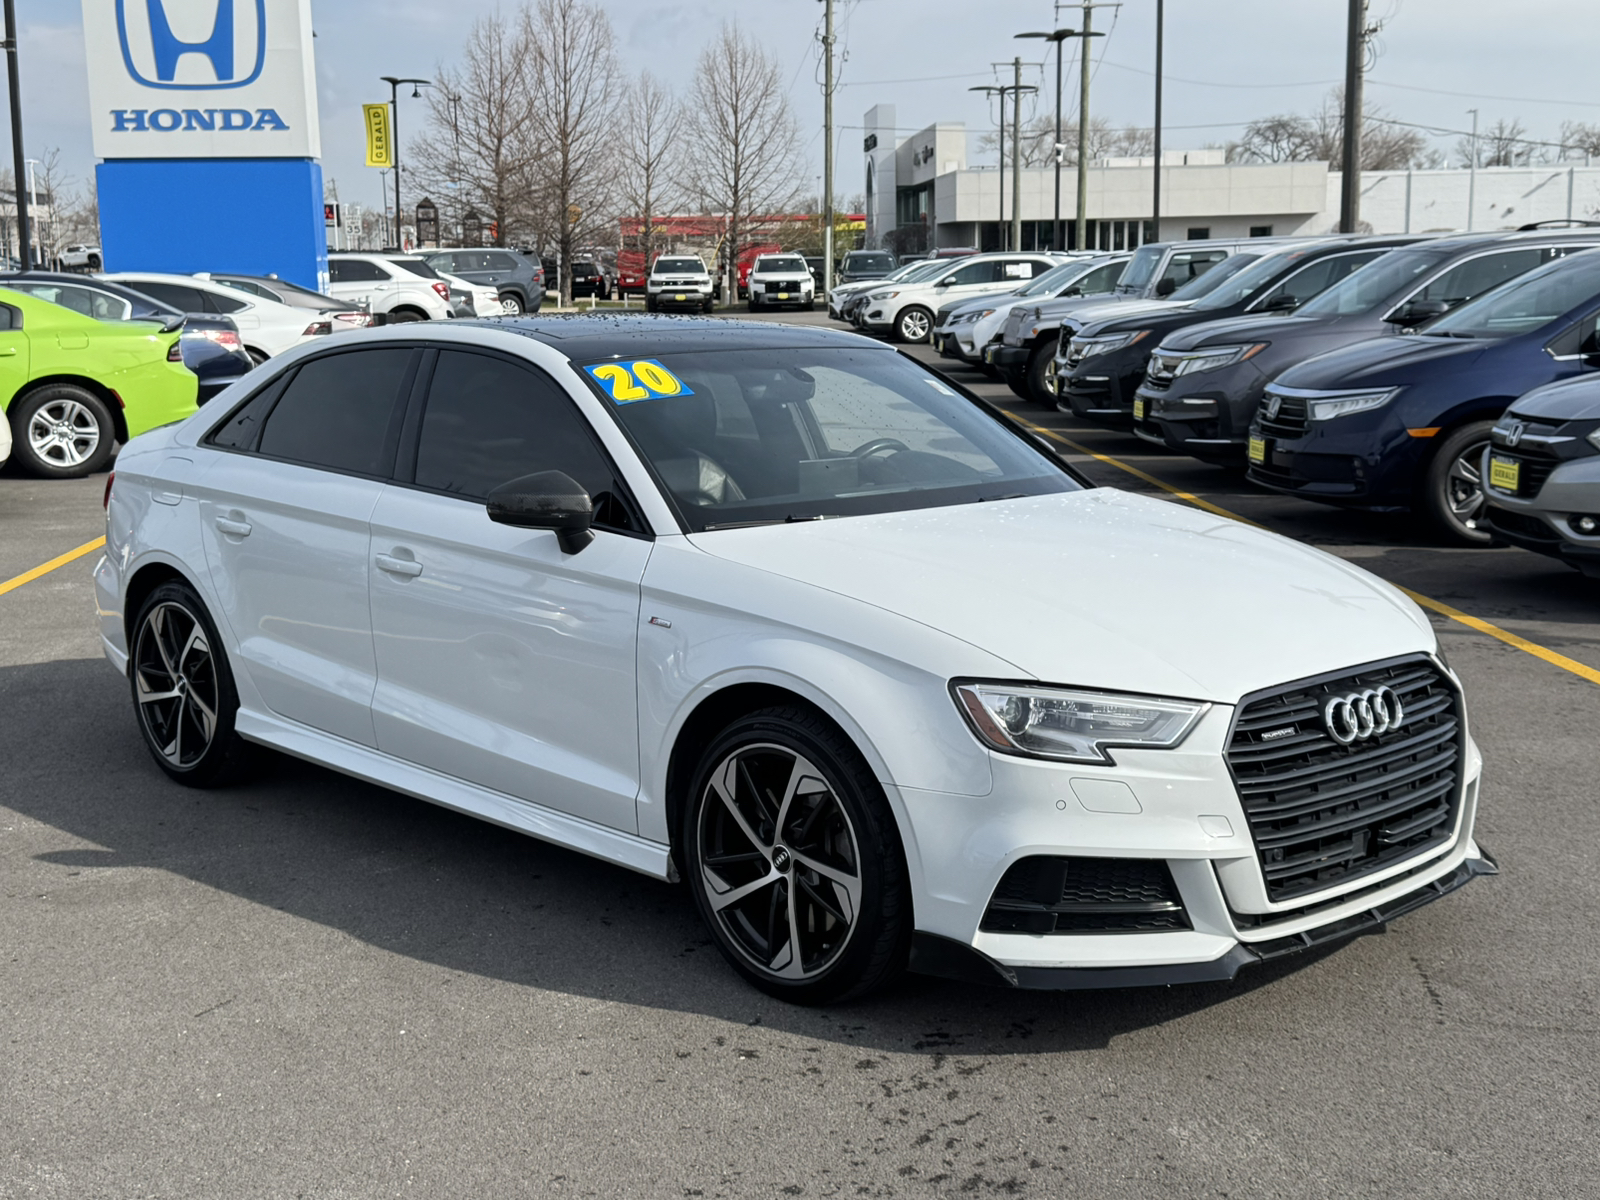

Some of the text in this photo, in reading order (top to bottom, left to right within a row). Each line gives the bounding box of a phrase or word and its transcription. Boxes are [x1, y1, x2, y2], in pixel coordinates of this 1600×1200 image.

[109, 108, 291, 132] HONDA
[373, 111, 384, 159] GERALD
[346, 226, 361, 234] 35
[592, 361, 682, 401] 20
[1493, 468, 1516, 481] GERALD
